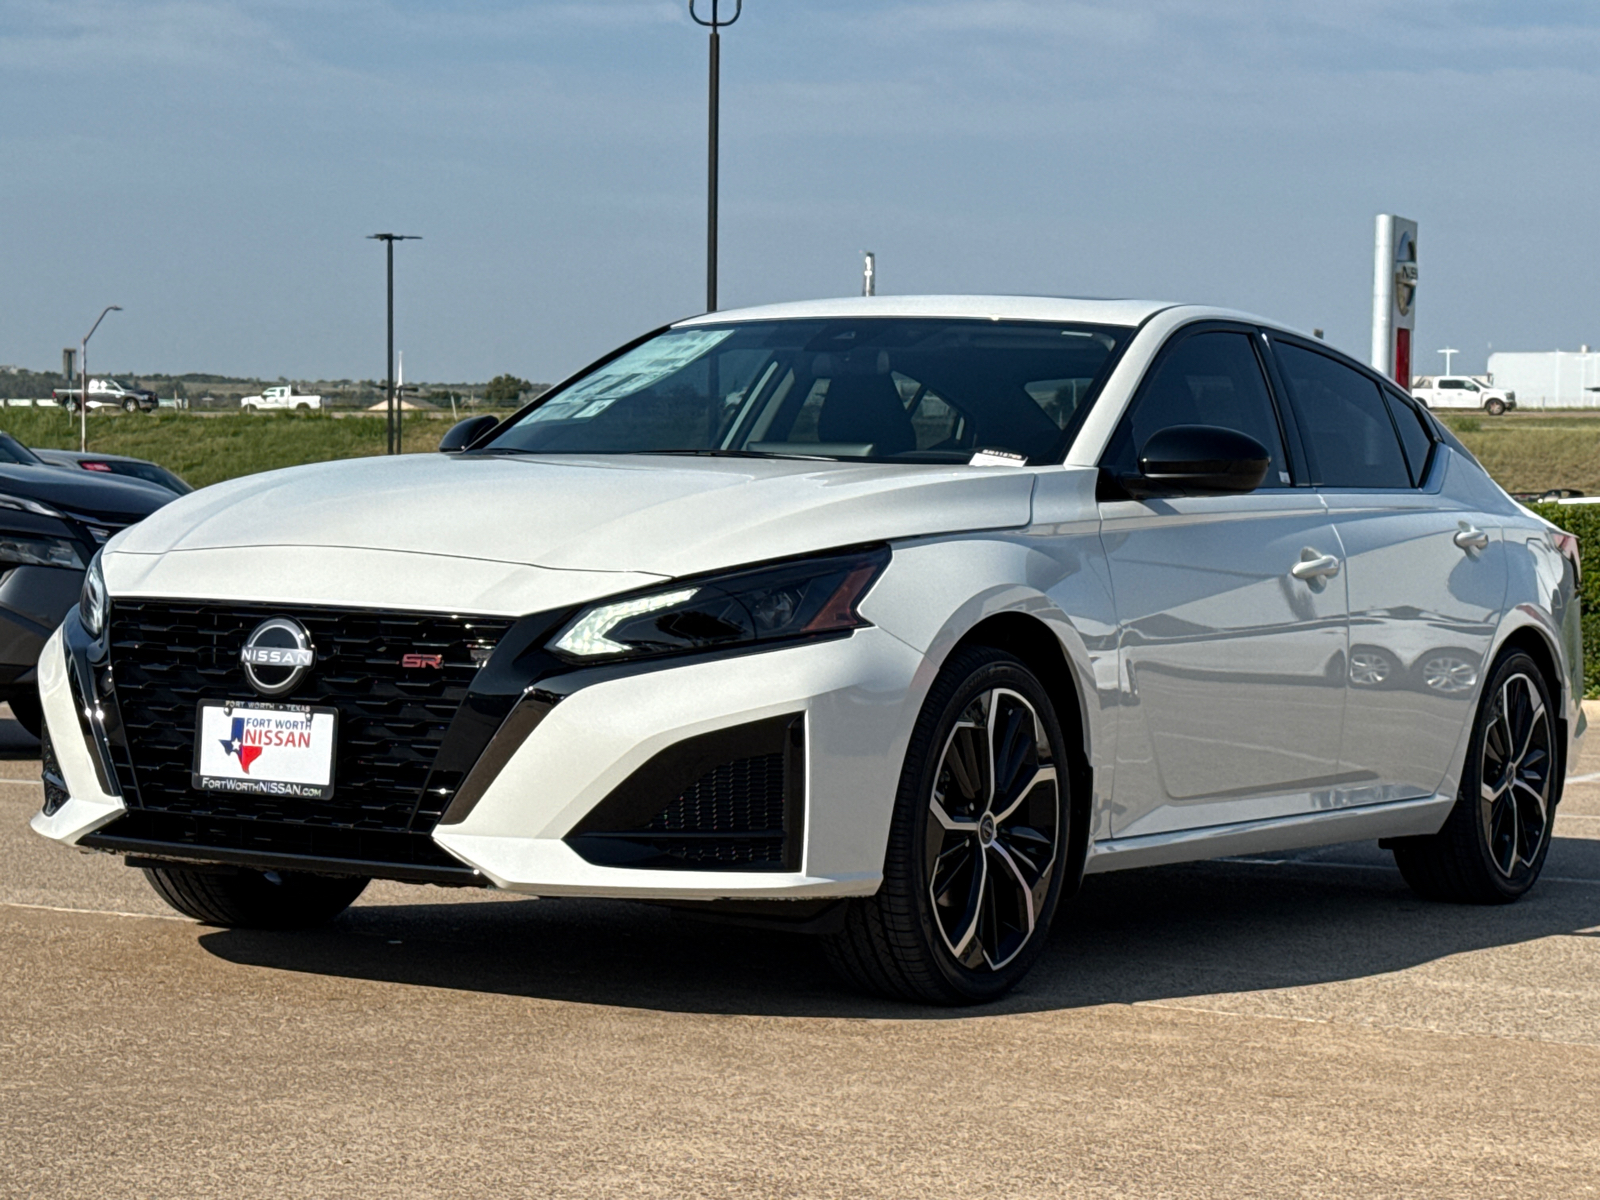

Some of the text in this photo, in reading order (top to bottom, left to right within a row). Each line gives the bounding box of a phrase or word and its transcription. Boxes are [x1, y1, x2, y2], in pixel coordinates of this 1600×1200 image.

[242, 649, 310, 664] NISSAN
[402, 653, 442, 669] SR
[225, 700, 311, 713] FORT WORTH TEXAS
[246, 718, 312, 731] FORT WORTH
[244, 729, 311, 748] NISSAN
